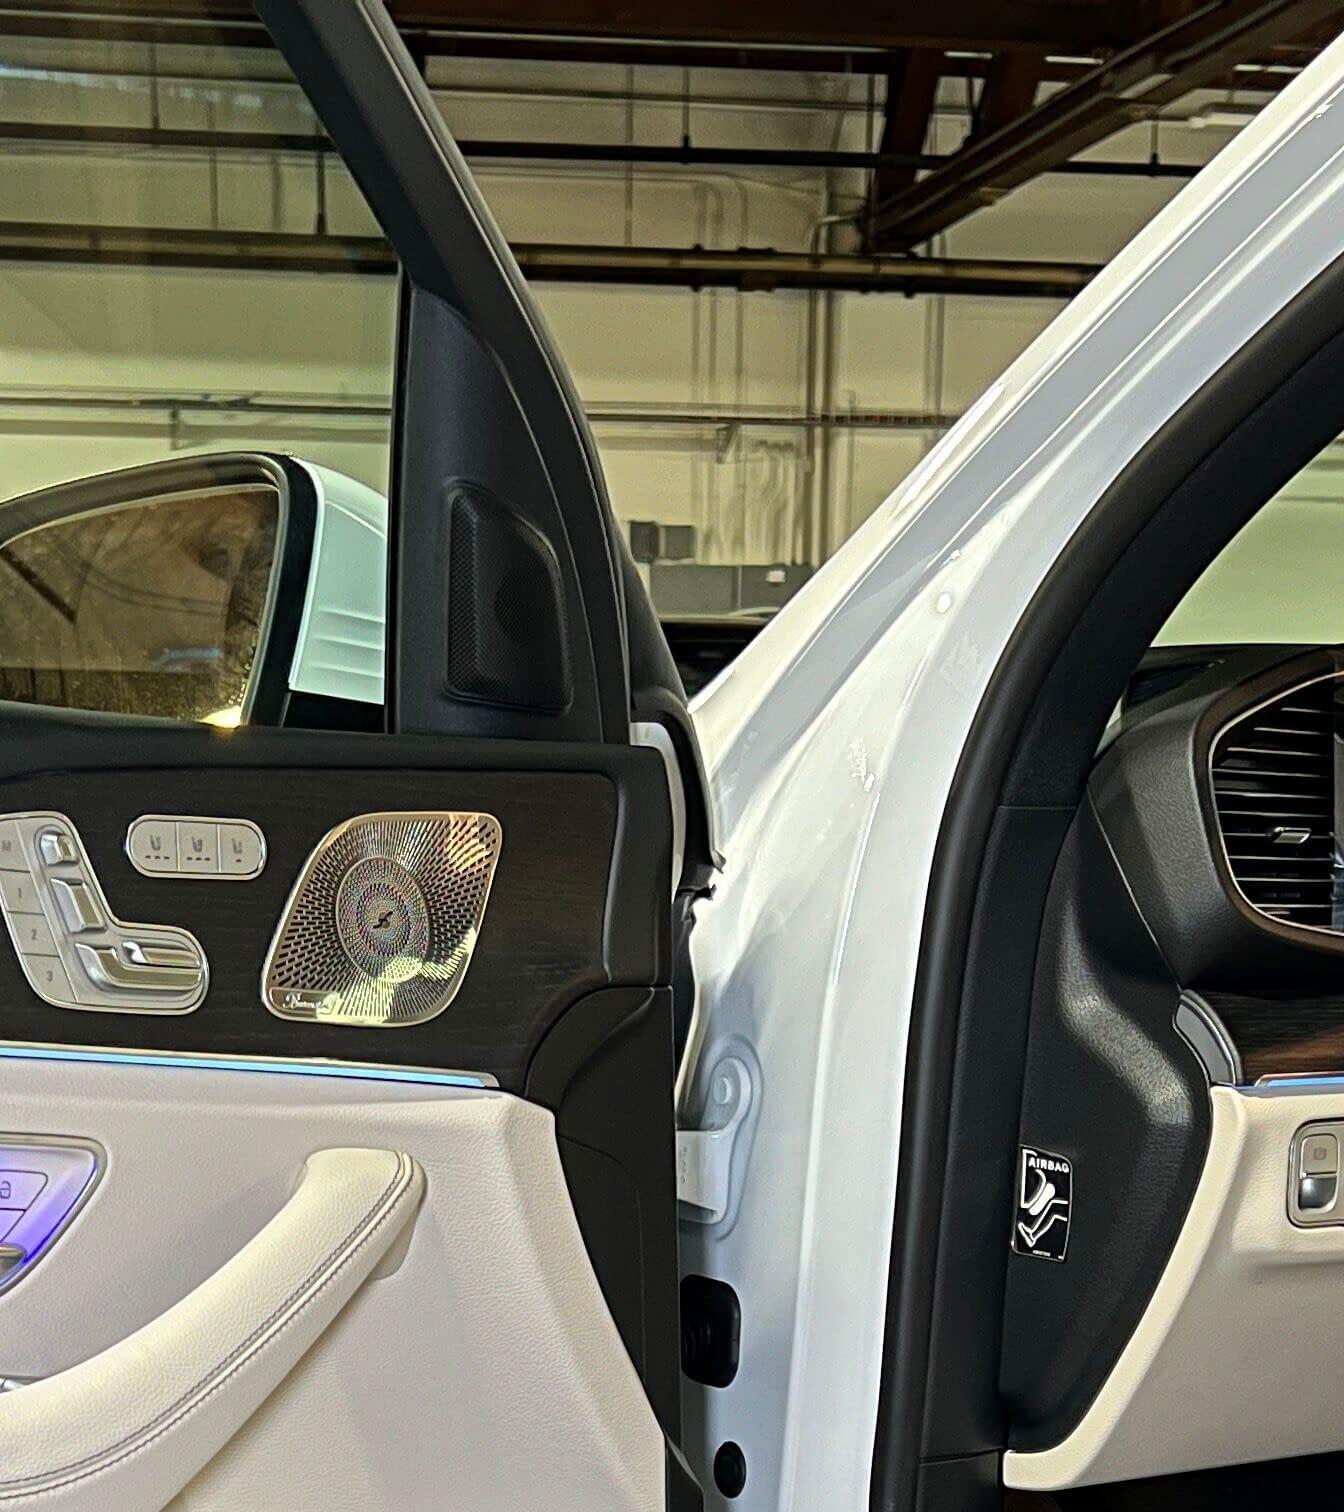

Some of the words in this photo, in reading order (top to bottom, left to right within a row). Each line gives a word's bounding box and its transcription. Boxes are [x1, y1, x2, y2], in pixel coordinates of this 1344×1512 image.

[31, 929, 38, 940] 2
[46, 970, 54, 982] 3
[1028, 1157, 1070, 1174] AIRBAG
